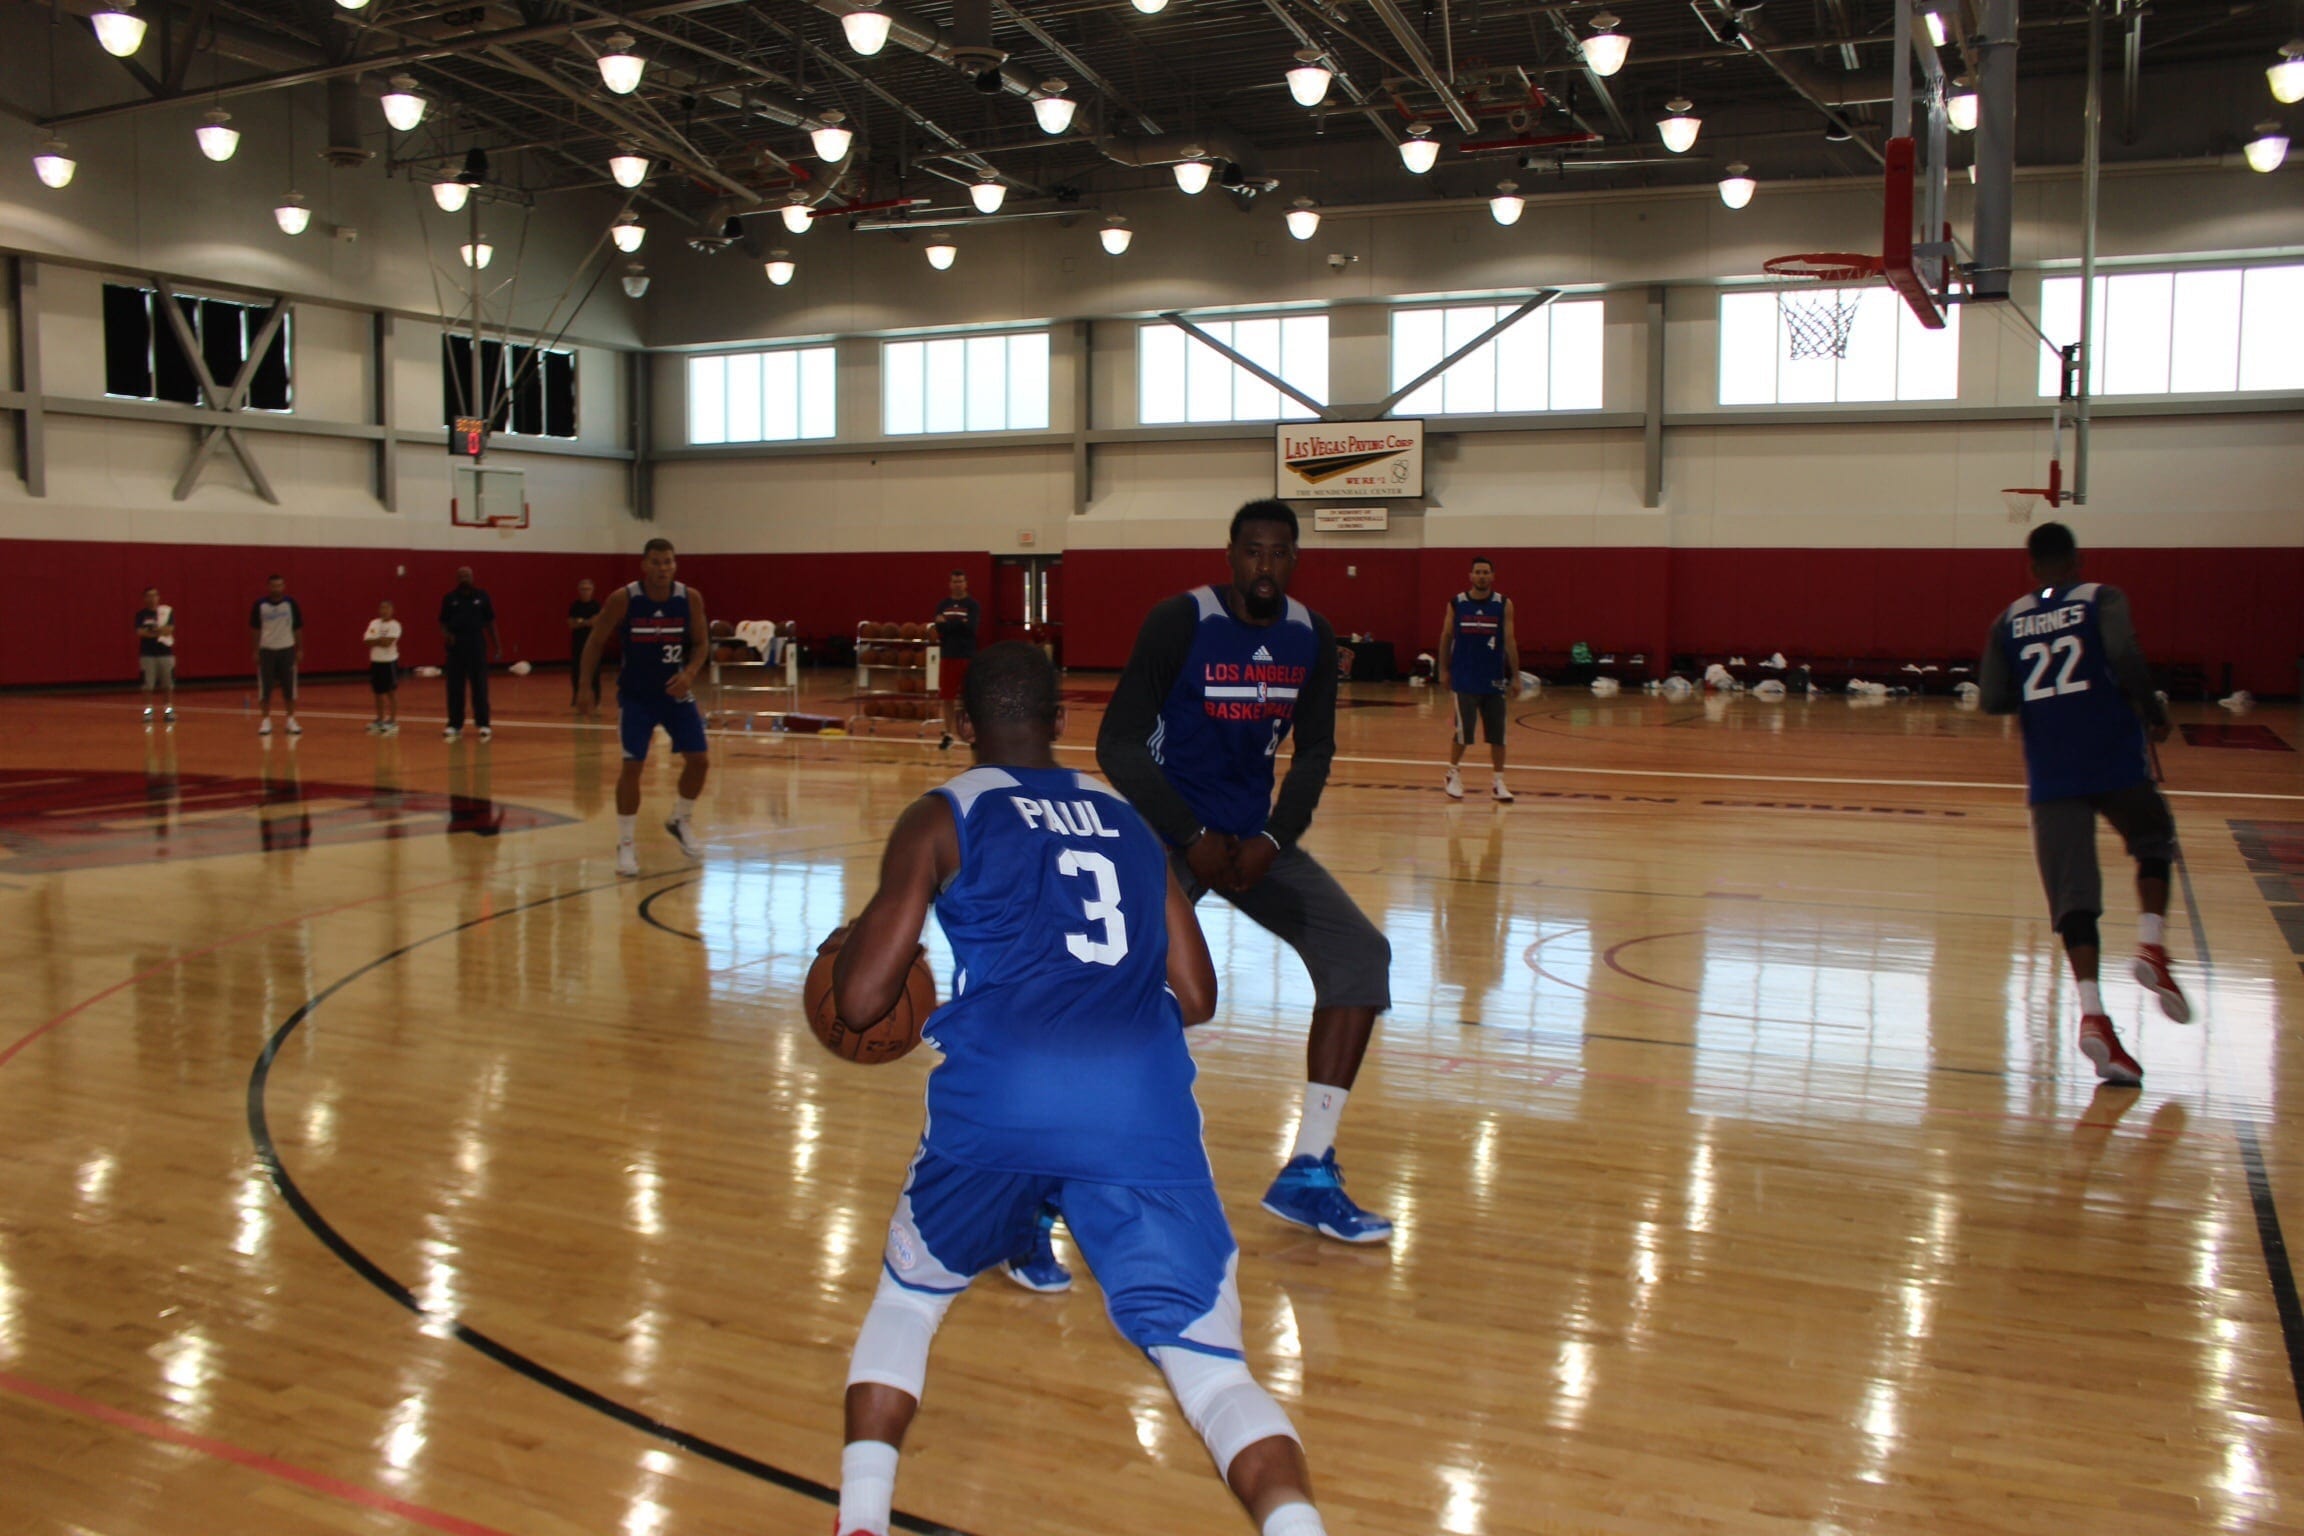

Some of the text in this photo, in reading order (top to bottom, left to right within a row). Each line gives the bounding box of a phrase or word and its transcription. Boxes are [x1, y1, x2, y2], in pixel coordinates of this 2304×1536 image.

[467, 432, 481, 455] 0
[1284, 437, 1309, 460] LAS
[1310, 436, 1348, 457] VEGAS
[1348, 435, 1385, 453] PAVING
[2011, 603, 2087, 639] BARNES
[661, 643, 683, 664] 32
[1486, 635, 1497, 651] 4
[1204, 663, 1307, 684] LOS ANGELES
[2019, 635, 2091, 701] 22
[1009, 795, 1120, 838] PAUL
[1056, 846, 1129, 967] 3
